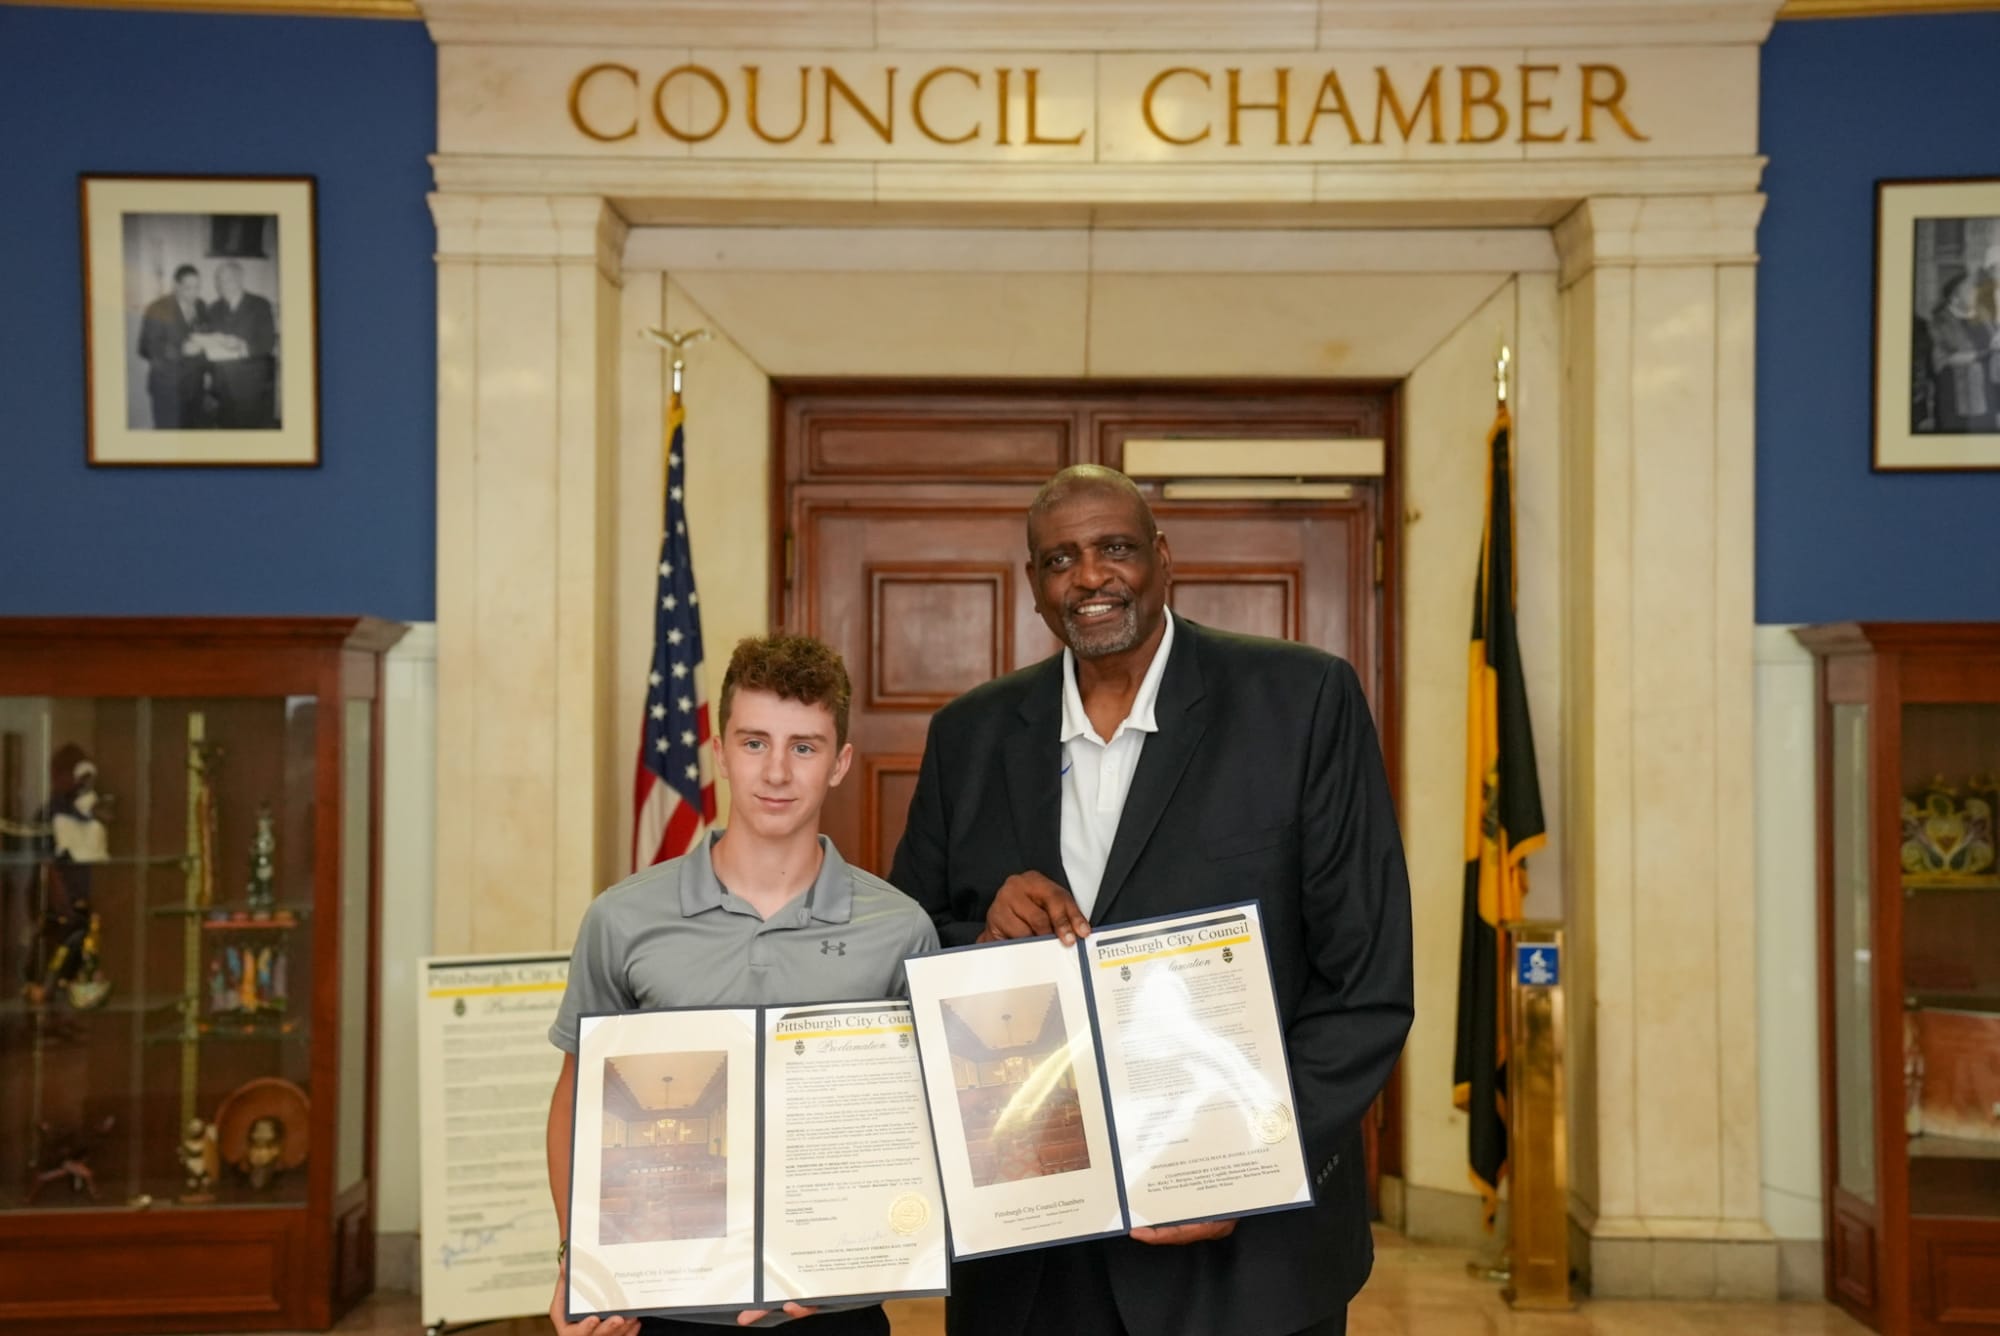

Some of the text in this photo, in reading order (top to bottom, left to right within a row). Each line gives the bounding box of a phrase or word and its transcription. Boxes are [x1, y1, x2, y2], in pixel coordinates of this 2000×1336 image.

[567, 62, 1651, 146] COUNCIL CHAMBER
[1097, 922, 1249, 960] Pittsburgh City Council
[776, 1013, 912, 1033] Pittsburgh City Coun
